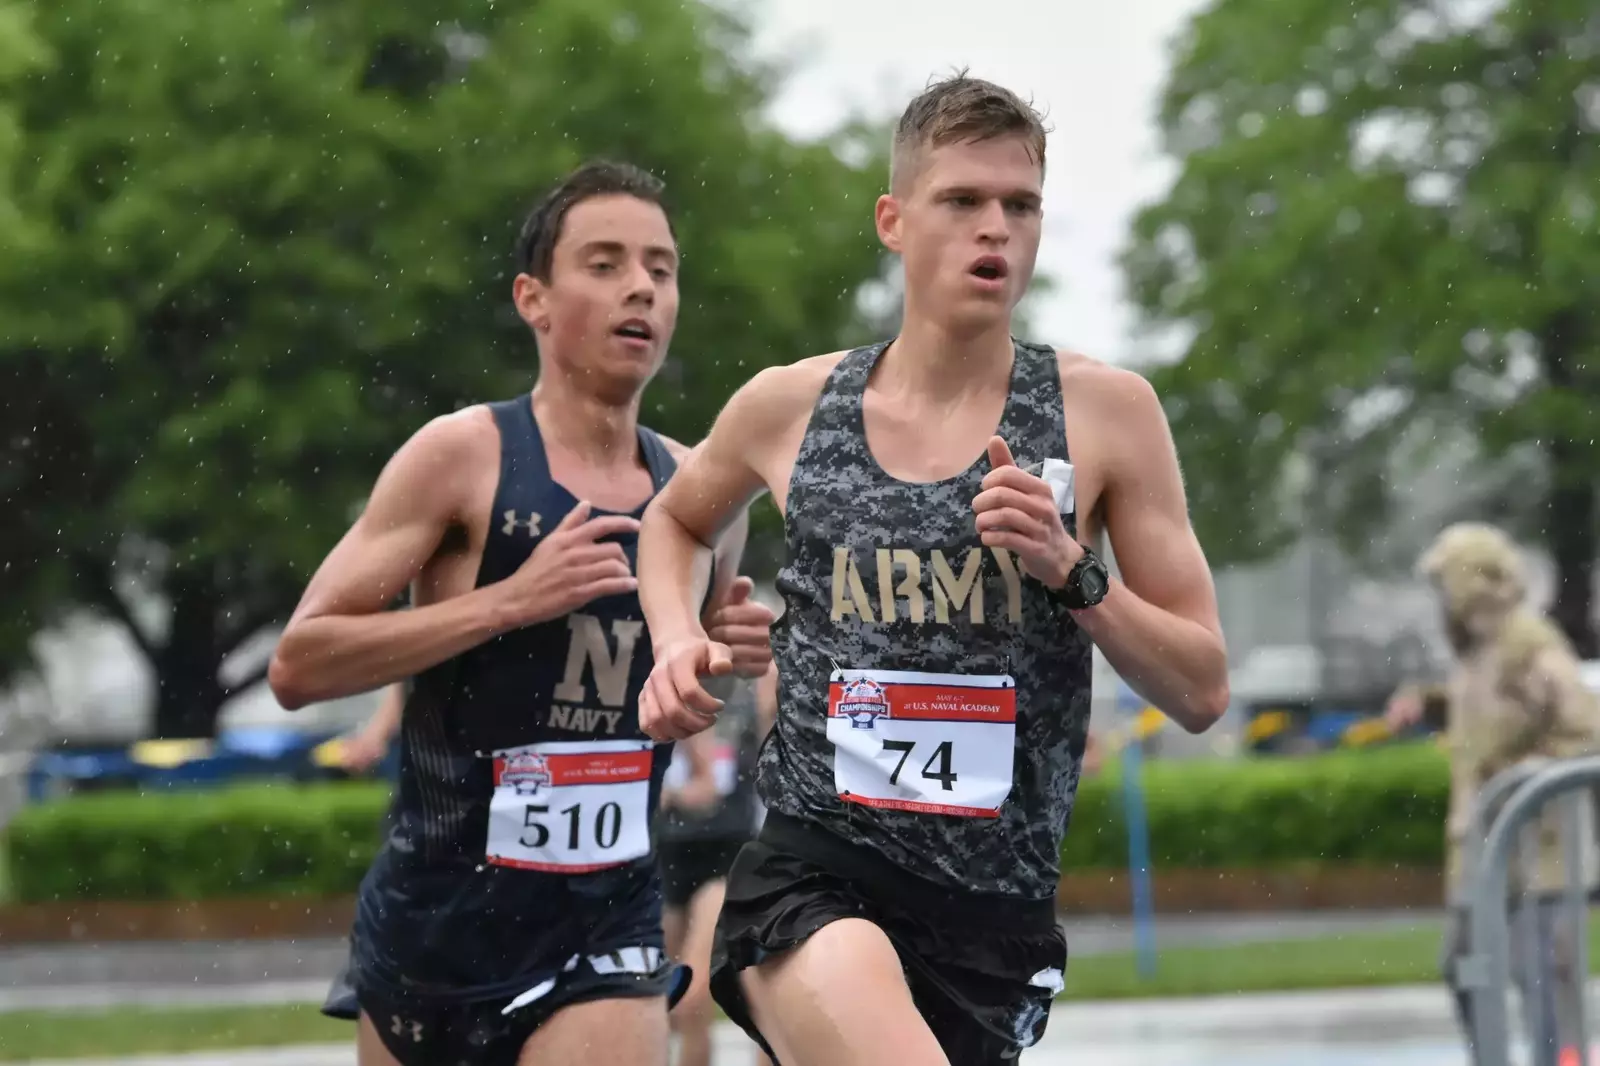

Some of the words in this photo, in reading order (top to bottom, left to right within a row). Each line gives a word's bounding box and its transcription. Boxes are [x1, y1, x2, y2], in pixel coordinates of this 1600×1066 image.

[830, 547, 1022, 624] ARMY
[553, 613, 644, 707] N
[547, 704, 624, 734] NAVY
[840, 703, 886, 712] CHAMPIONSHIPS
[913, 702, 929, 710] U.S.
[931, 703, 957, 711] NAVAL
[960, 704, 1001, 713] ACADEMY
[883, 739, 957, 791] 74
[519, 801, 622, 850] 510
